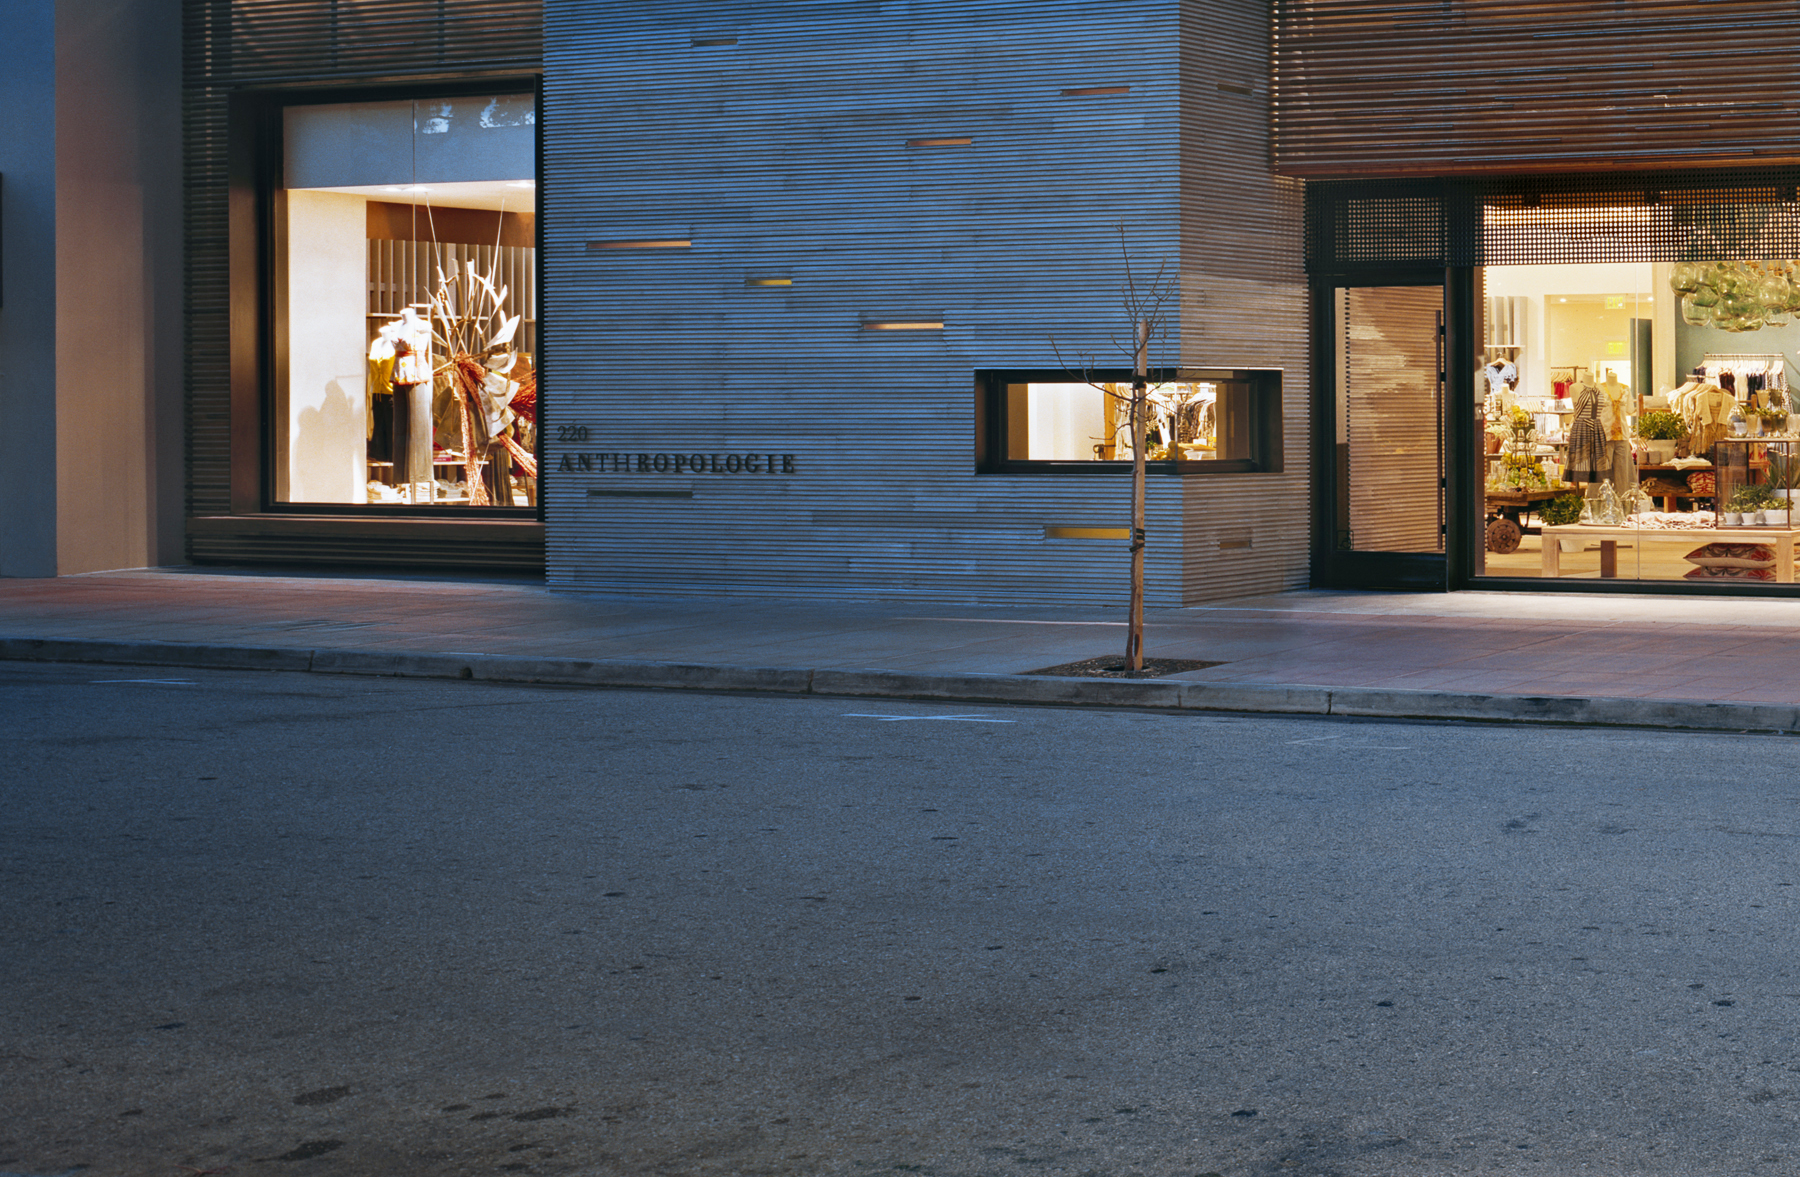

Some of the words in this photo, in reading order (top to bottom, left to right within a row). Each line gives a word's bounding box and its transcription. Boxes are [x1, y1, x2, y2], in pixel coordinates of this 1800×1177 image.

[1607, 296, 1623, 309] EXIT
[557, 426, 588, 442] 220
[557, 453, 795, 473] ANTHROPOLOGIE
